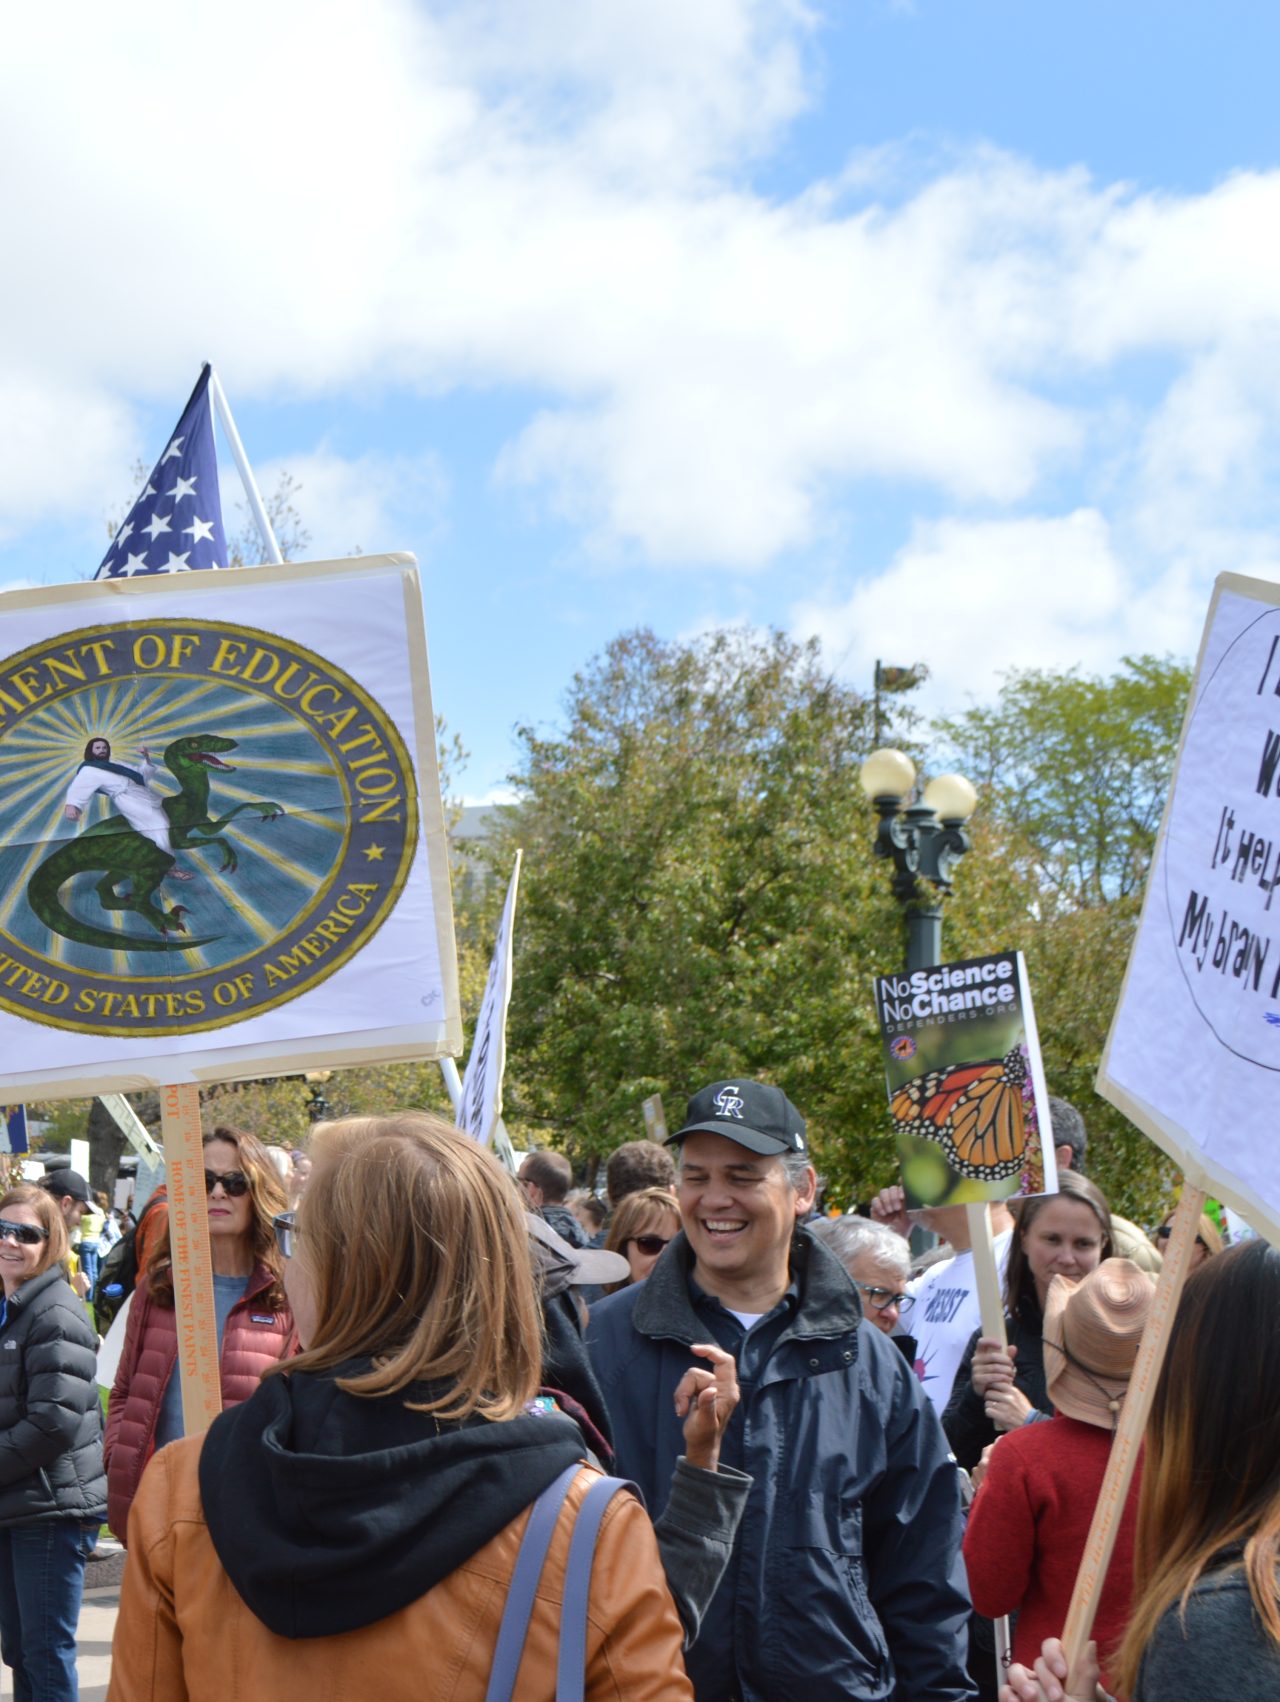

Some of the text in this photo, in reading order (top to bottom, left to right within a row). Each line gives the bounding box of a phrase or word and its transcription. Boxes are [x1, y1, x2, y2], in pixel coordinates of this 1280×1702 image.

[133, 634, 200, 669] OF
[208, 639, 401, 823] EDUCATION
[74, 988, 207, 1019] STATES
[213, 972, 256, 1006] OF
[262, 882, 379, 989] AMERICA
[1178, 889, 1214, 973] My
[887, 1002, 1017, 1033] DEFENDERS.ORG
[171, 1161, 185, 1206] HOME
[175, 1210, 187, 1229] OF
[176, 1235, 189, 1265] THE
[179, 1269, 193, 1319] FINEST
[183, 1324, 198, 1377] PAINTS
